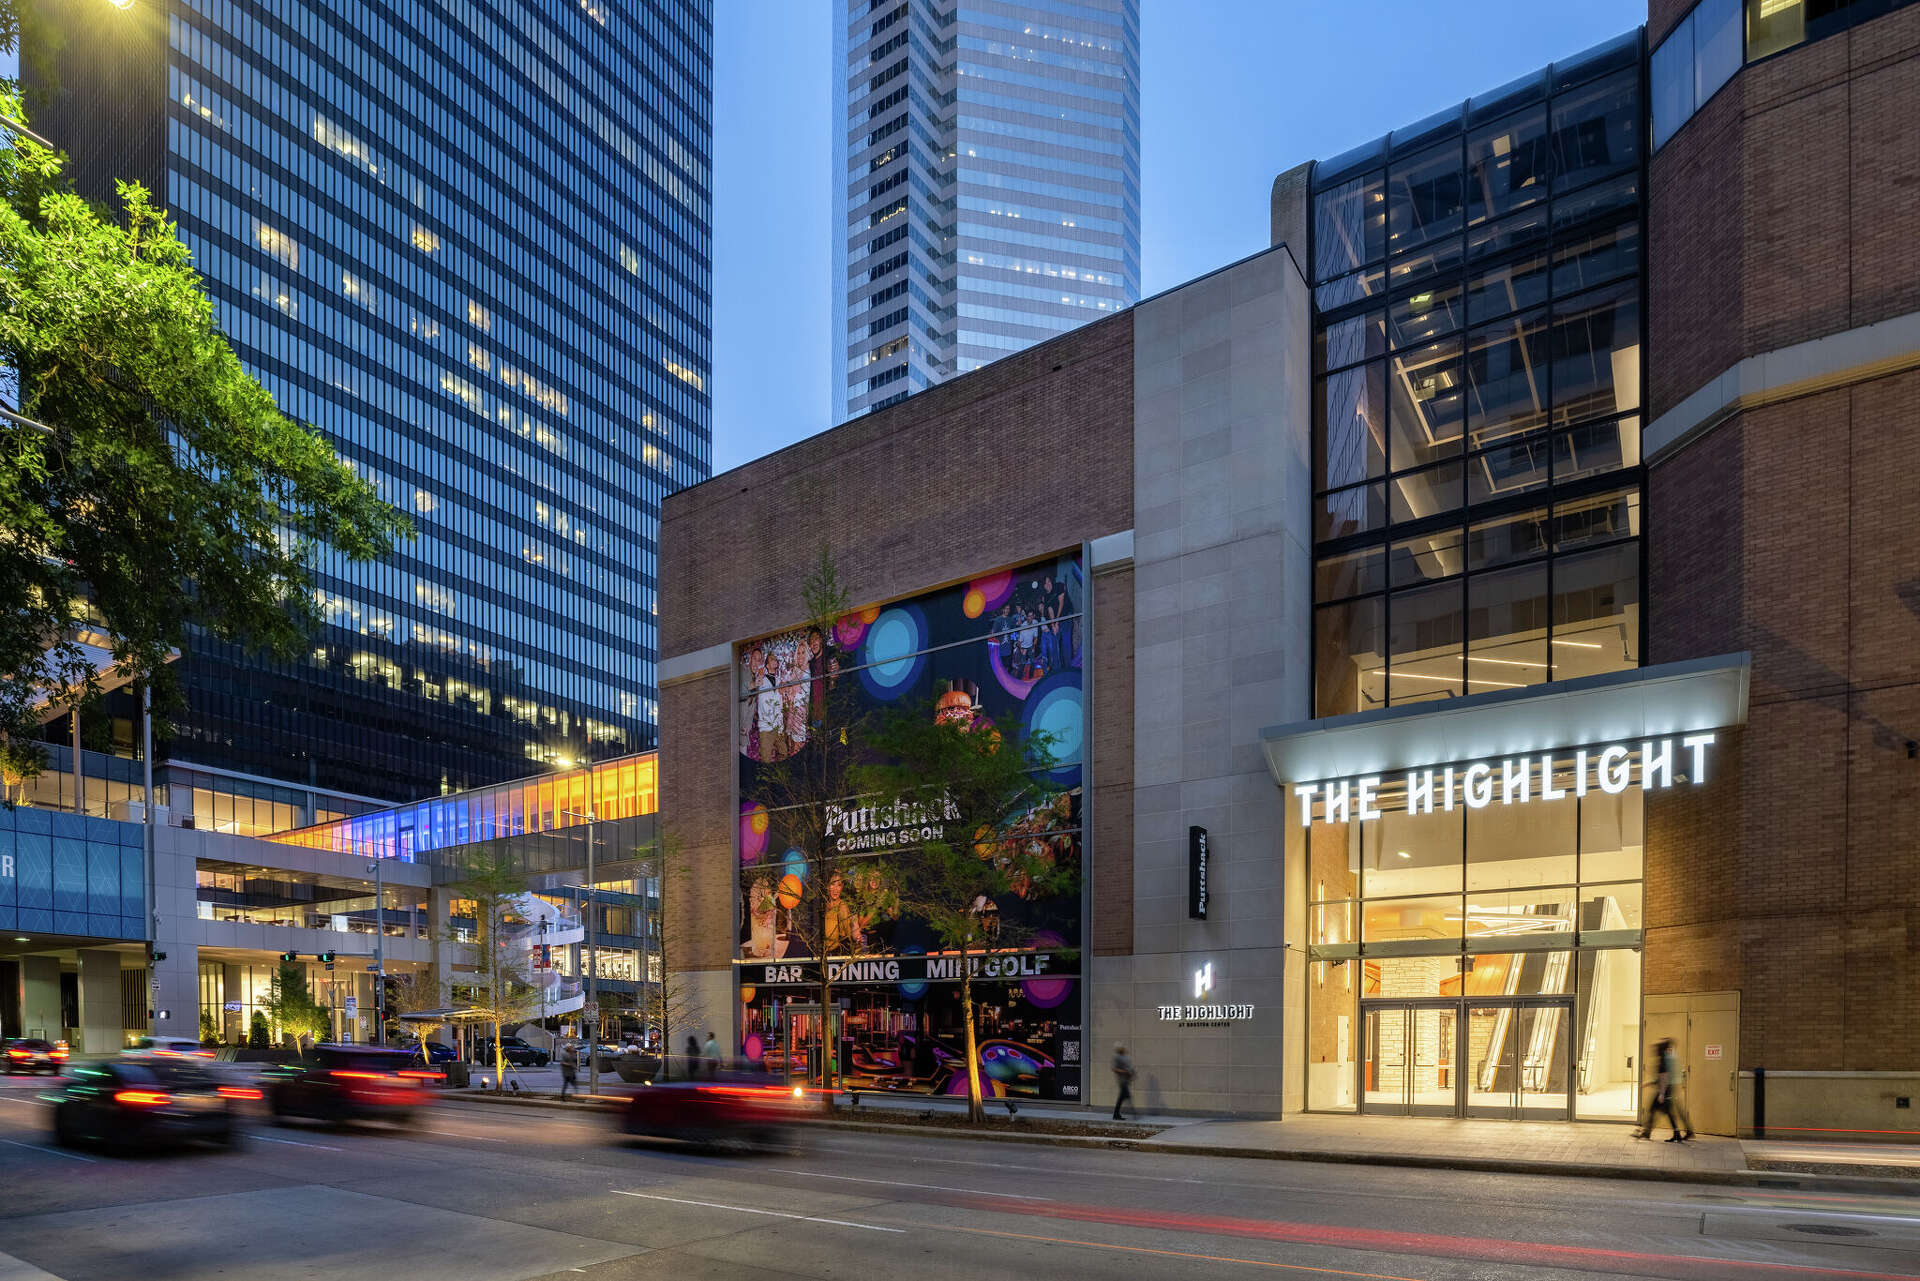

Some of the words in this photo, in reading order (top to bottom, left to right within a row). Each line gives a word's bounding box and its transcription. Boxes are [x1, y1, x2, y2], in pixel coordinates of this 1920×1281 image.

[1294, 777, 1381, 826] THE
[1408, 734, 1715, 816] HIGHLIGHT
[836, 831, 896, 851] COMING
[900, 825, 943, 843] SOON
[765, 966, 802, 983] BAR
[828, 961, 899, 981] DINING
[927, 958, 979, 978] MINI
[984, 955, 1050, 977] GOLF
[1157, 1006, 1181, 1020] THE
[1185, 1005, 1254, 1020] HIGHLIGHT
